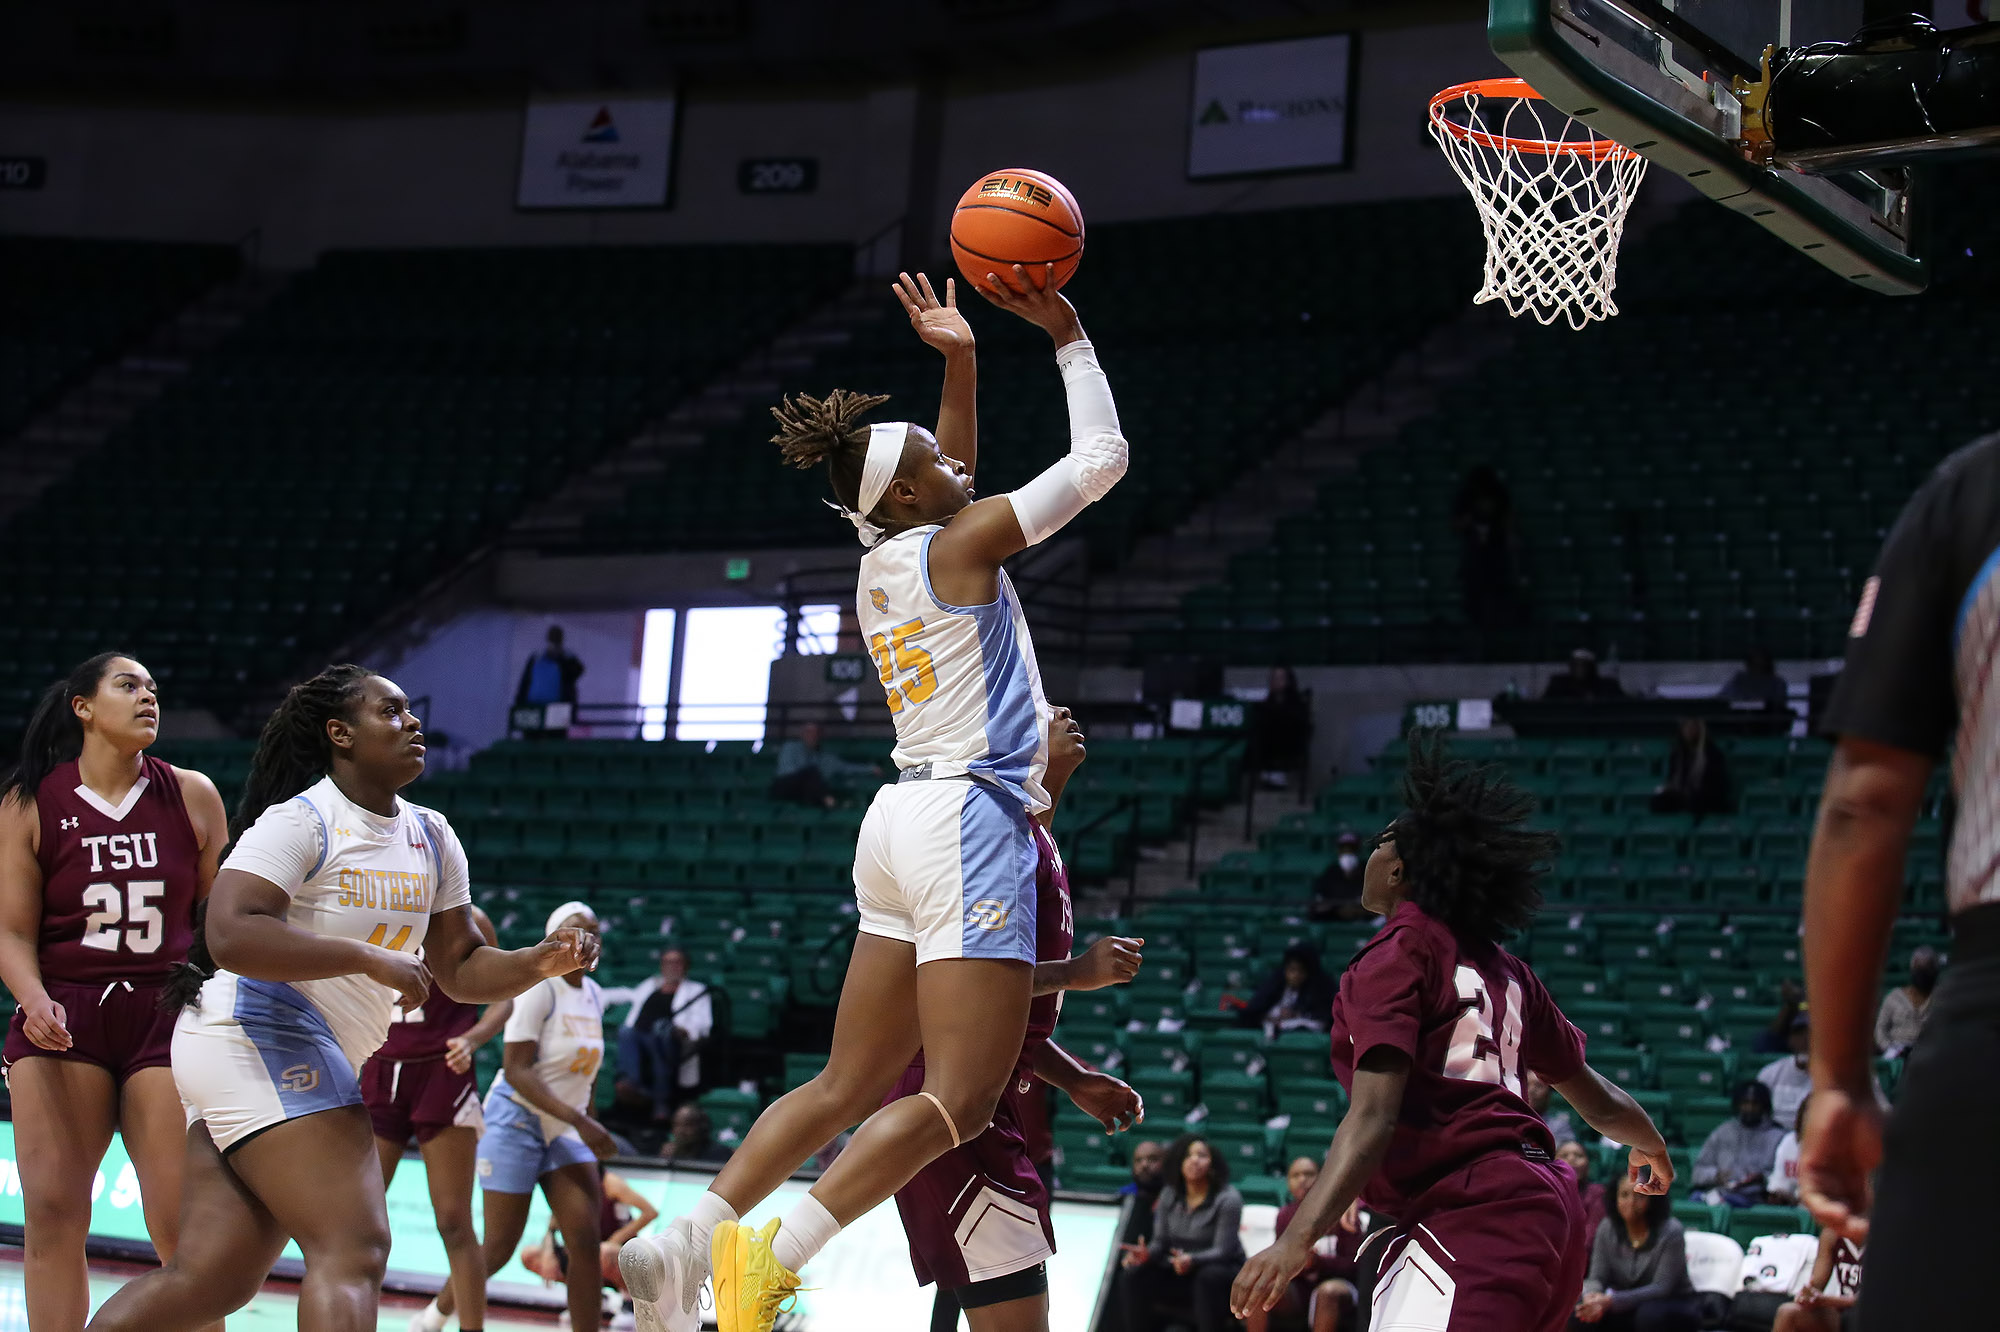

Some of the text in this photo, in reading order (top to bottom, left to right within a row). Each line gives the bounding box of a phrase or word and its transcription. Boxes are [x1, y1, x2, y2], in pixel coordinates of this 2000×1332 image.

[750, 163, 804, 189] 209
[980, 178, 1054, 208] ELITE
[1414, 704, 1450, 728] 105
[81, 832, 158, 872] TSU
[80, 880, 165, 954] 25
[1442, 964, 1523, 1099] 24
